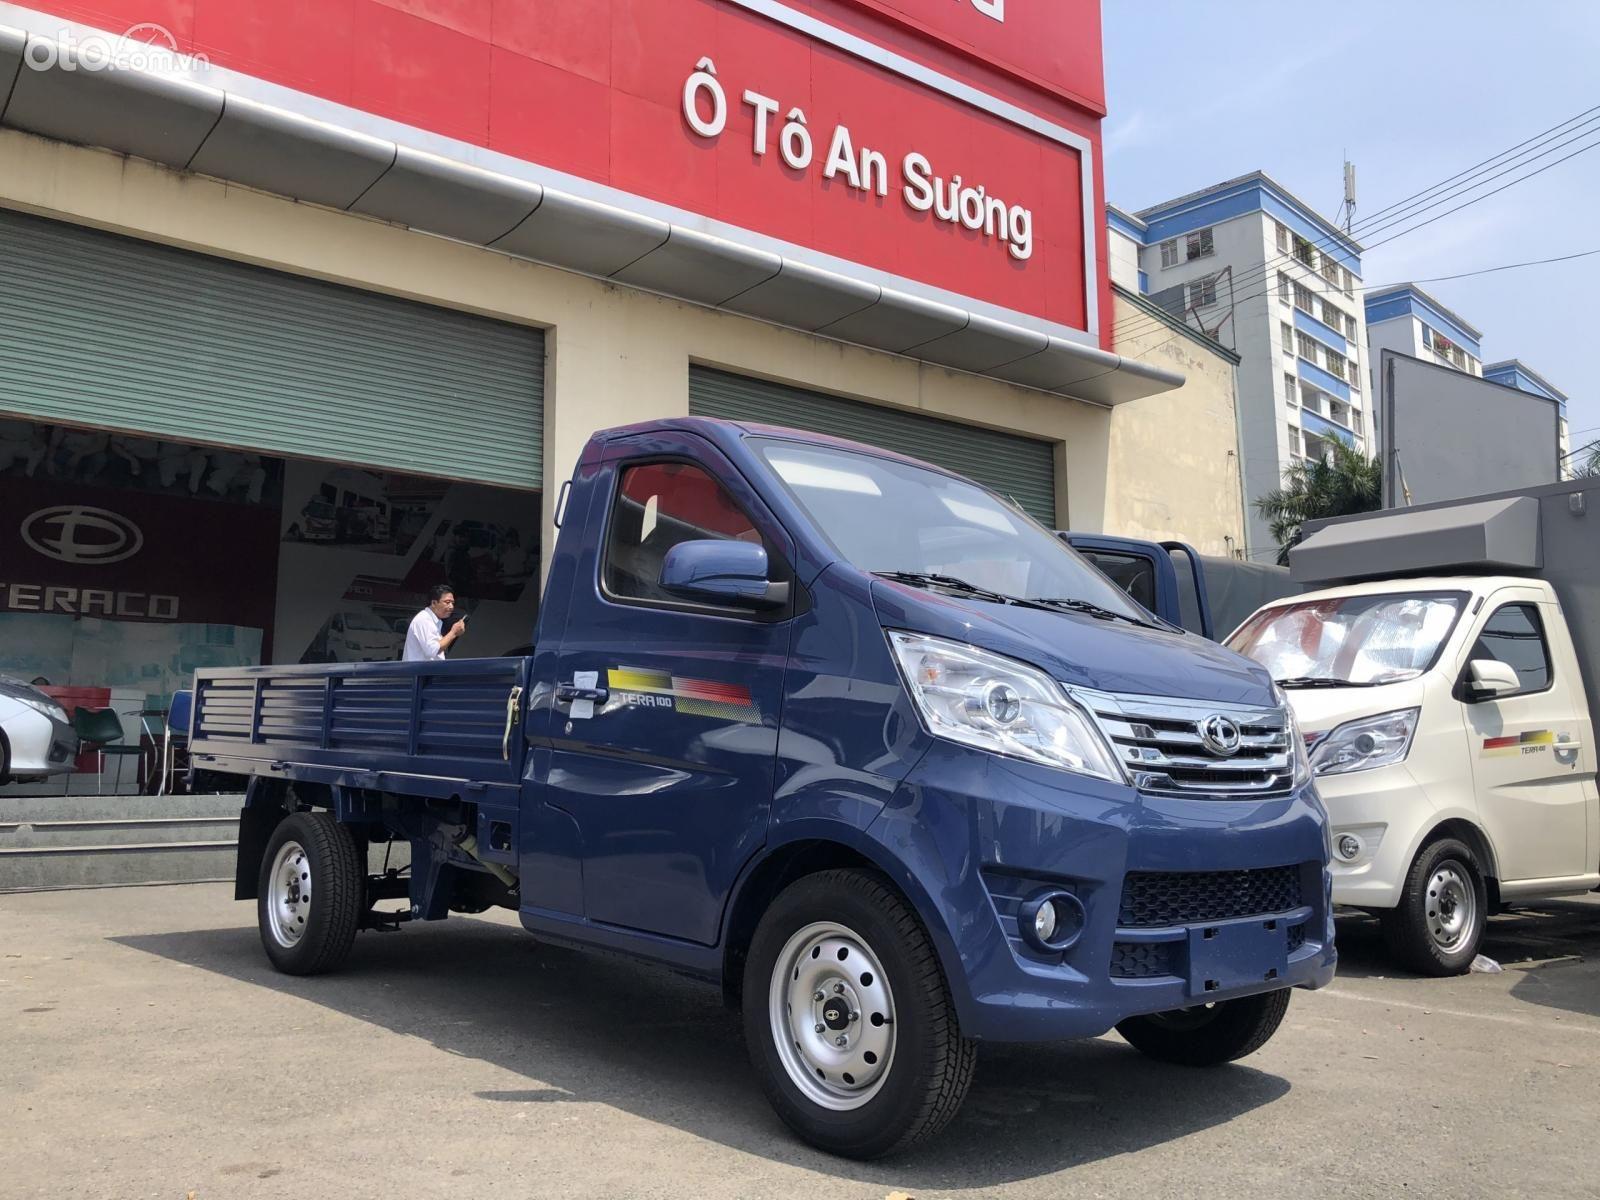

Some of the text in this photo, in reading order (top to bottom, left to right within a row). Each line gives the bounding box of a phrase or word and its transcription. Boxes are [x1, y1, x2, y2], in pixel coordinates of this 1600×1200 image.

[683, 56, 1033, 260] Ô Tô An Sương
[0, 582, 180, 619] ERACO
